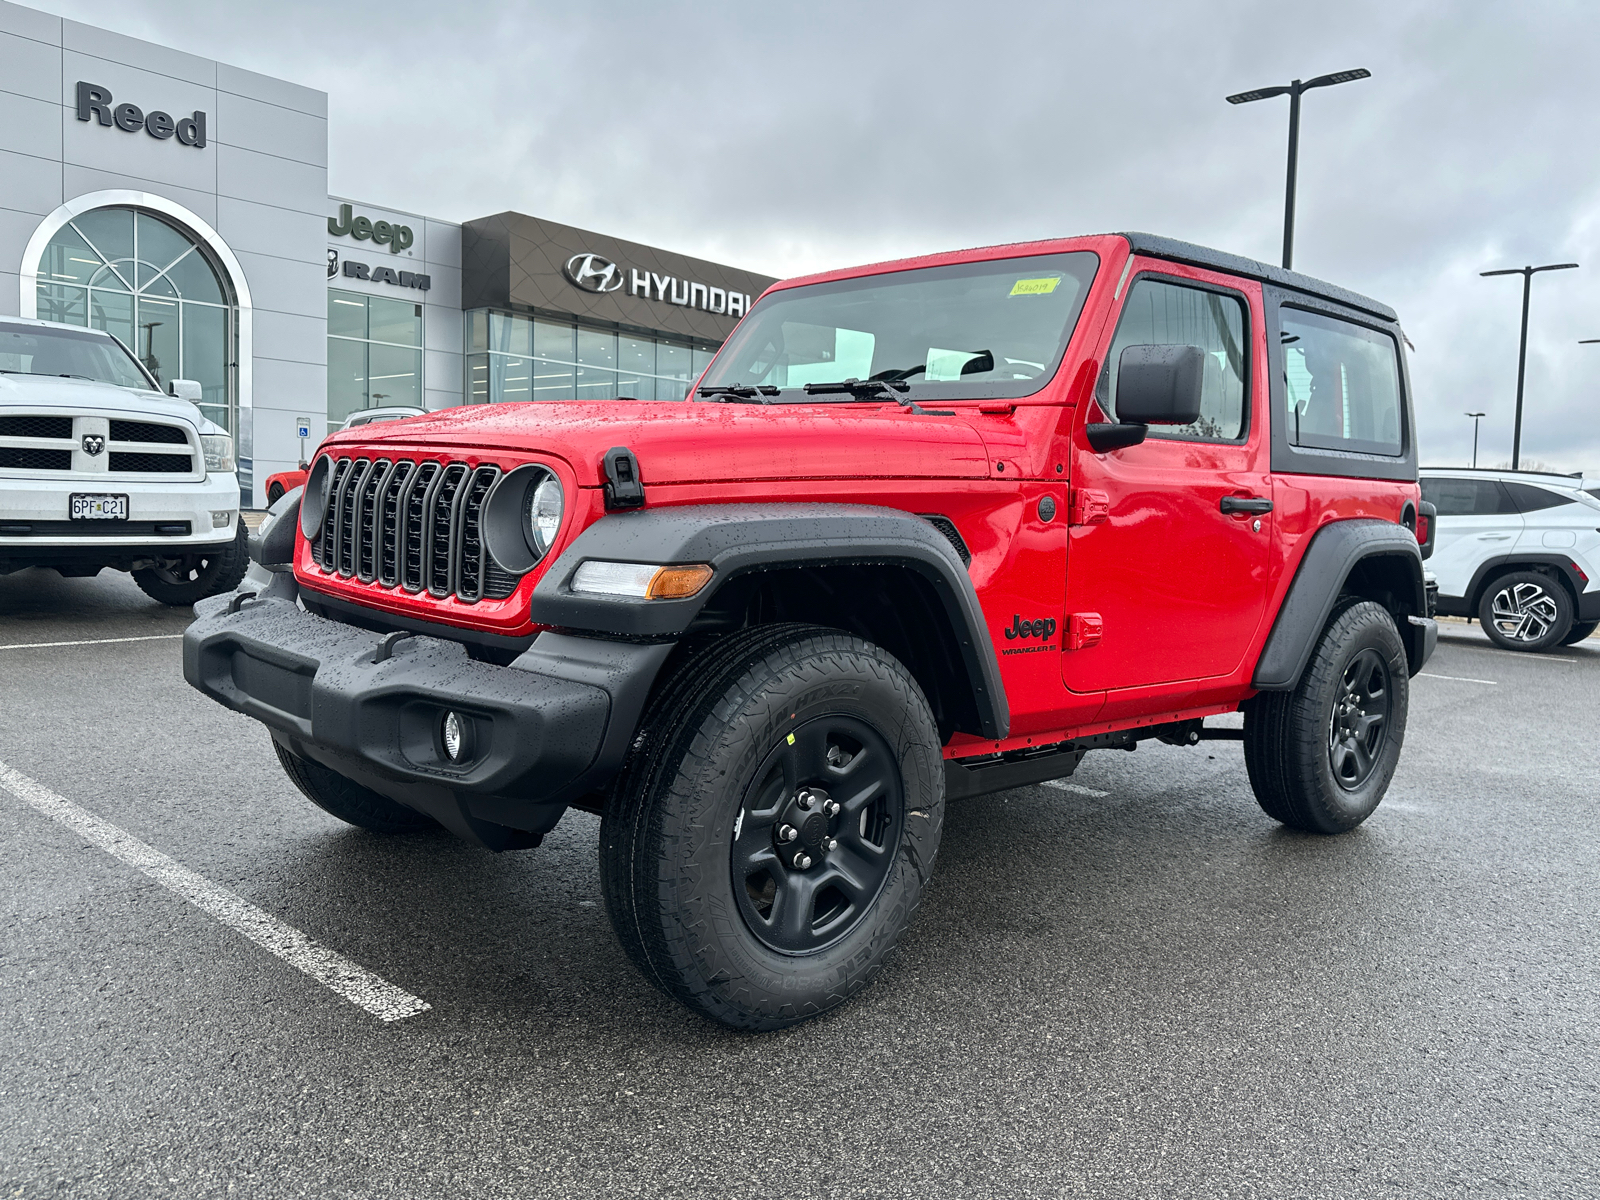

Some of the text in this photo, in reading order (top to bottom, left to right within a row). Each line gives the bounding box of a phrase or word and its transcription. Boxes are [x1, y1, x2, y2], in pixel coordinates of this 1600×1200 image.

[76, 81, 207, 148] Reed
[327, 203, 414, 254] Jeep
[343, 260, 431, 291] RAM
[73, 500, 124, 515] 6PF C21
[1004, 613, 1057, 642] Jeep
[1001, 645, 1049, 656] WRANGLER
